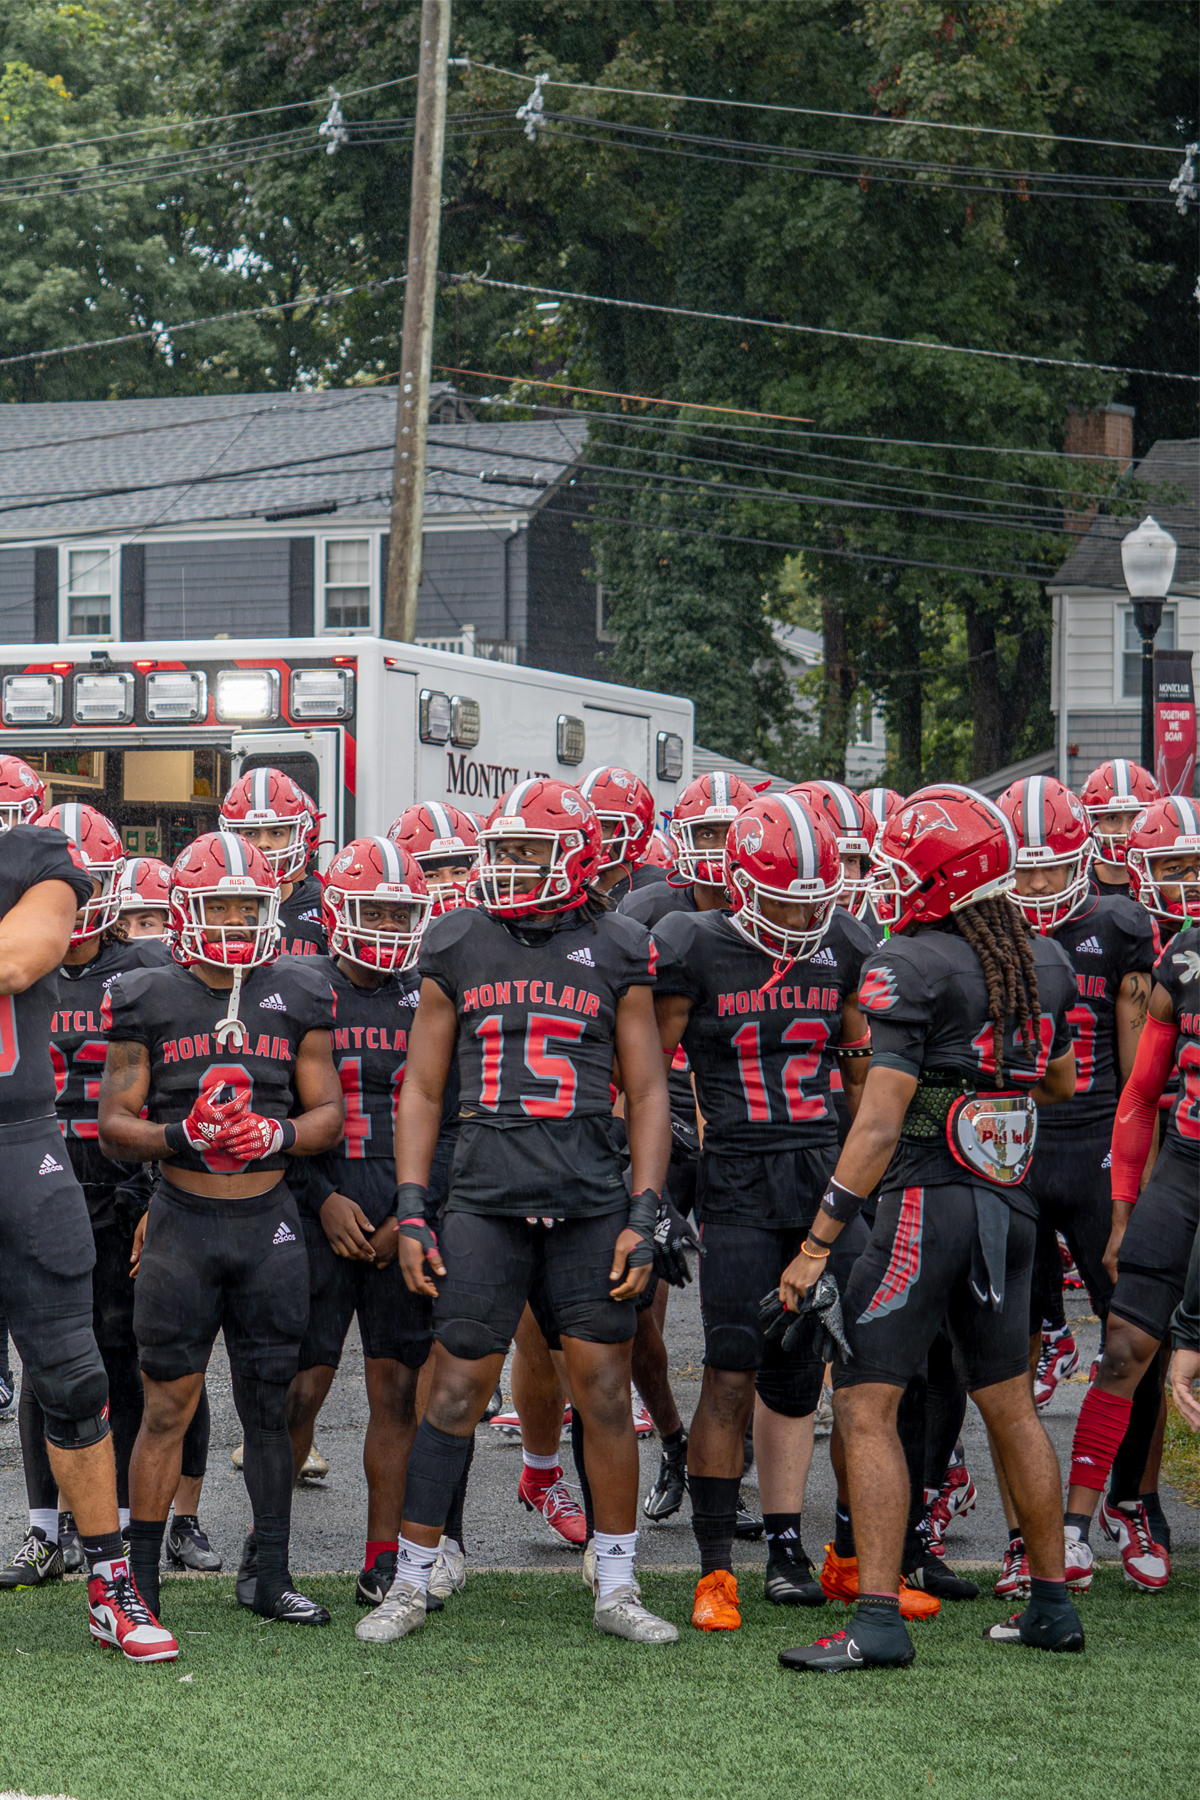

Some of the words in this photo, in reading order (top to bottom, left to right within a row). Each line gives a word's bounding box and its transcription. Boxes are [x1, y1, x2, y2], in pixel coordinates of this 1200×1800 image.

[1159, 709, 1190, 720] TOGETHER
[1168, 721, 1179, 731] WE
[1164, 732, 1183, 742] SOAR
[800, 882, 818, 890] RISE
[1075, 945, 1103, 955] adidas
[566, 953, 596, 968] adidas
[809, 956, 838, 967] adidas
[463, 979, 601, 1018] MONTCLAIR
[717, 985, 839, 1017] MONTCLAIR
[259, 1000, 287, 1012] adidas
[329, 1026, 411, 1052] NTCLA
[474, 1011, 588, 1119] 15
[730, 1017, 832, 1123] 12
[38, 1164, 64, 1176] adidas
[272, 1233, 296, 1245] adidas
